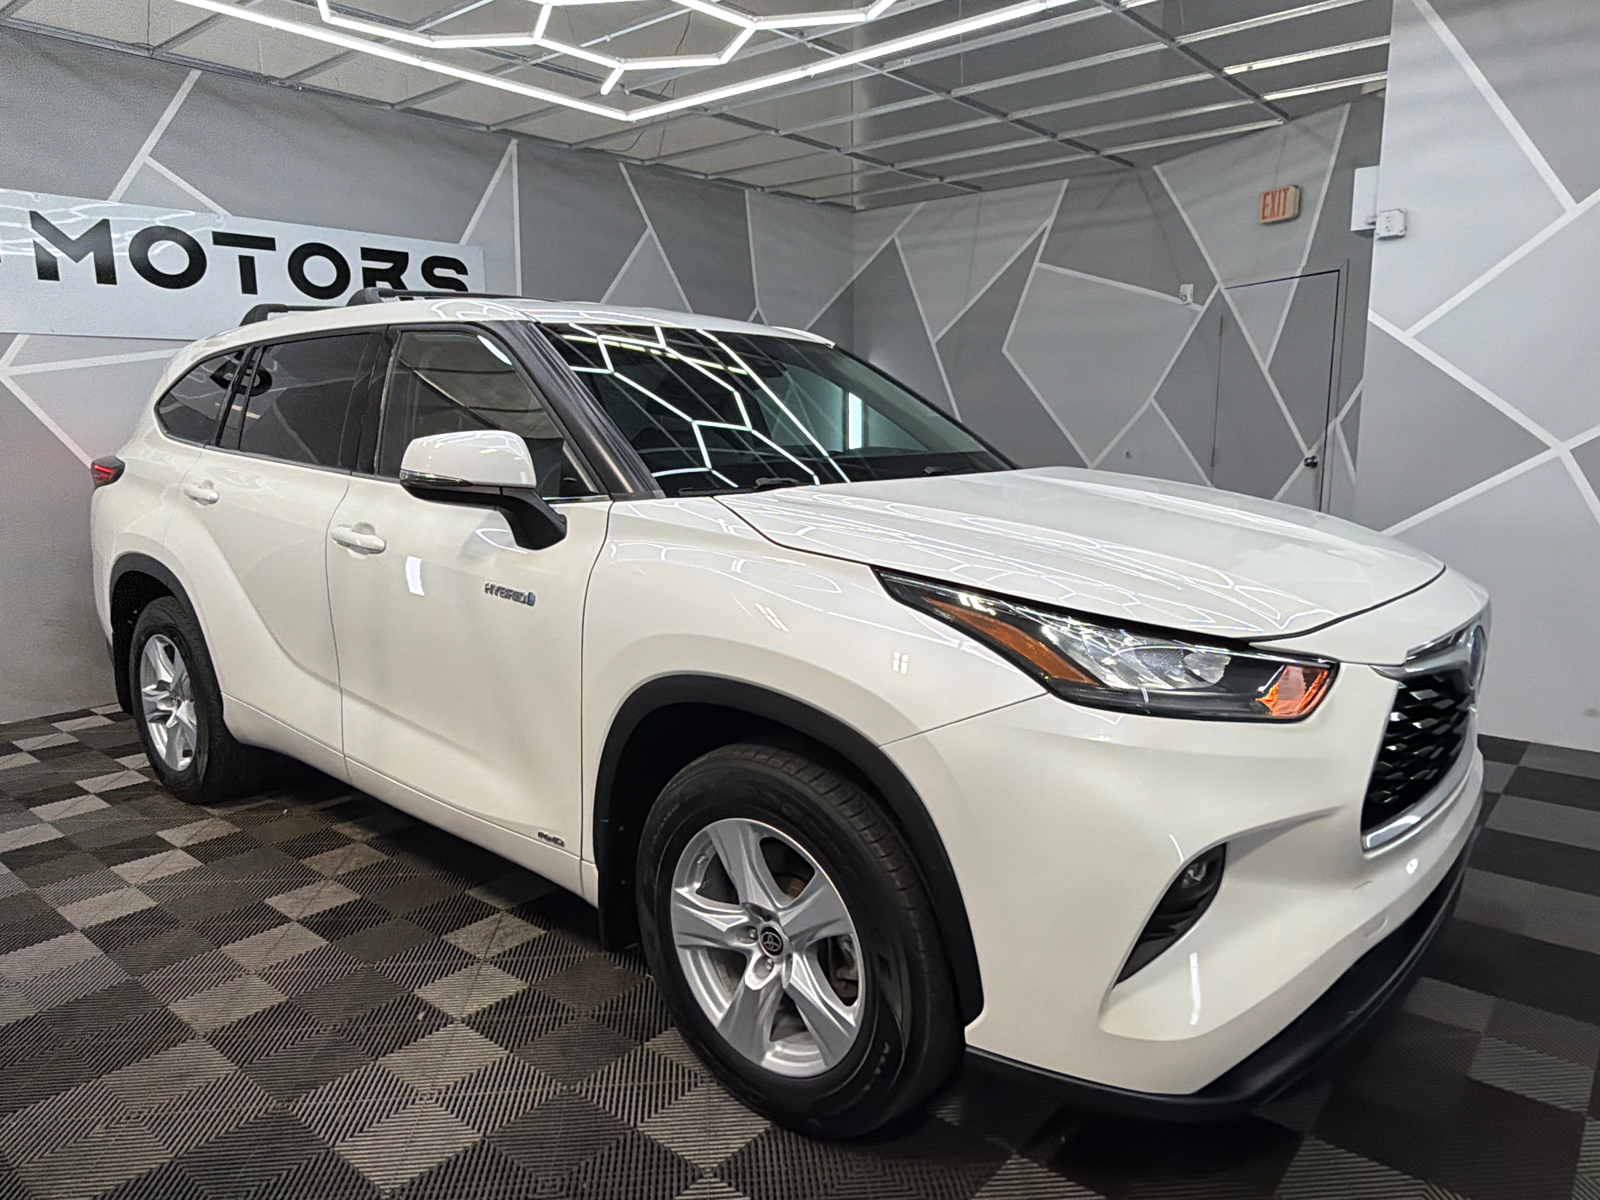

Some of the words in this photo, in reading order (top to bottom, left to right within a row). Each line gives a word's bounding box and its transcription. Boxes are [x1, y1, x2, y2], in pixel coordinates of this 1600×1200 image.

[1262, 188, 1290, 220] EXIT
[28, 210, 468, 300] MOTORS
[484, 582, 527, 604] HYBRID
